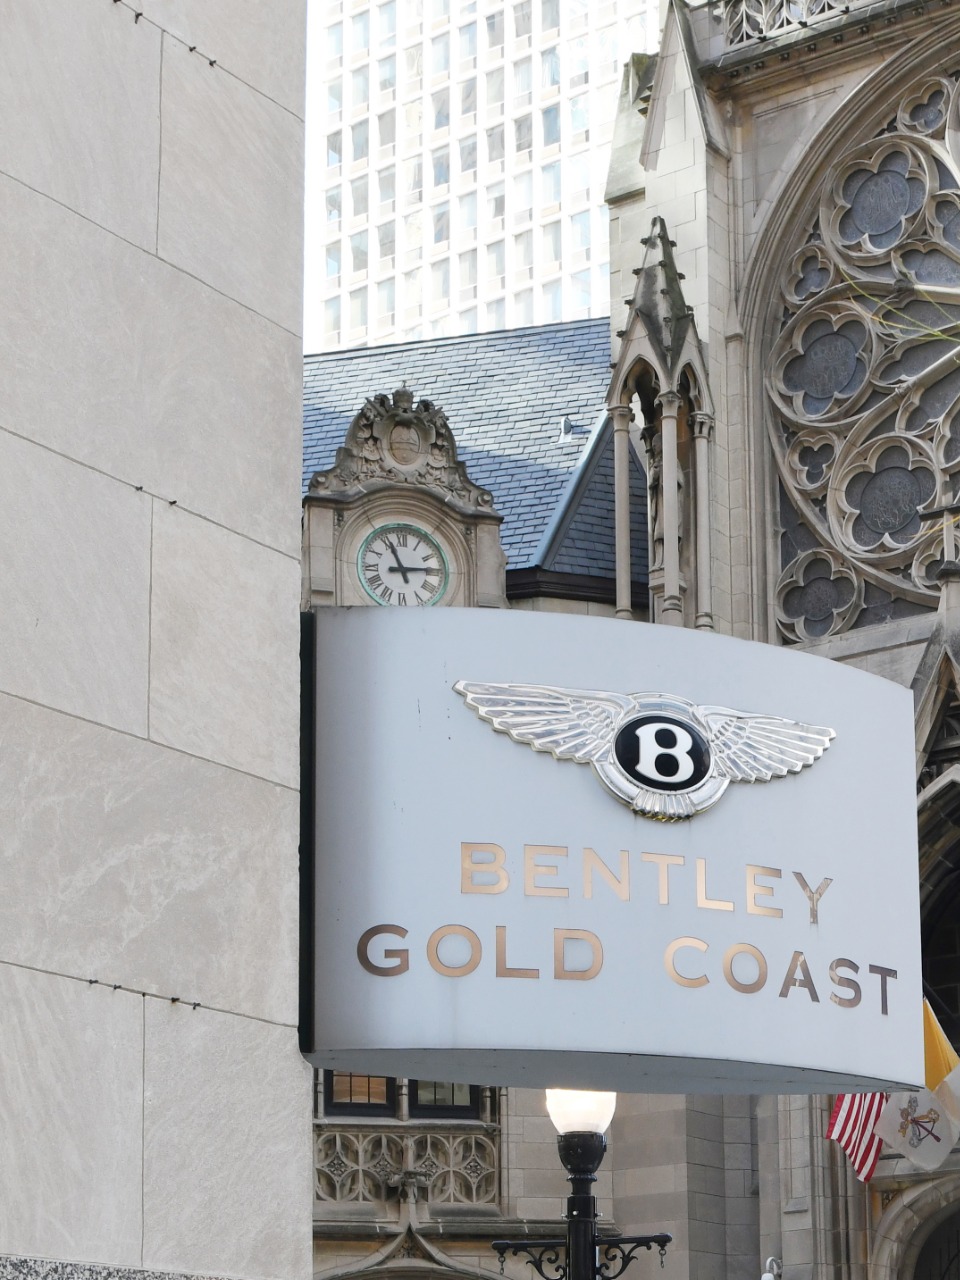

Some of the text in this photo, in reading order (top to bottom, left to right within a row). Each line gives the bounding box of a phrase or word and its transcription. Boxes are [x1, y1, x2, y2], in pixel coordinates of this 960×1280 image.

[368, 545, 383, 559] X
[396, 534, 407, 548] XII
[637, 722, 693, 784] B
[460, 842, 834, 924] BENTLEY
[356, 924, 898, 1016] GOLD COAST
